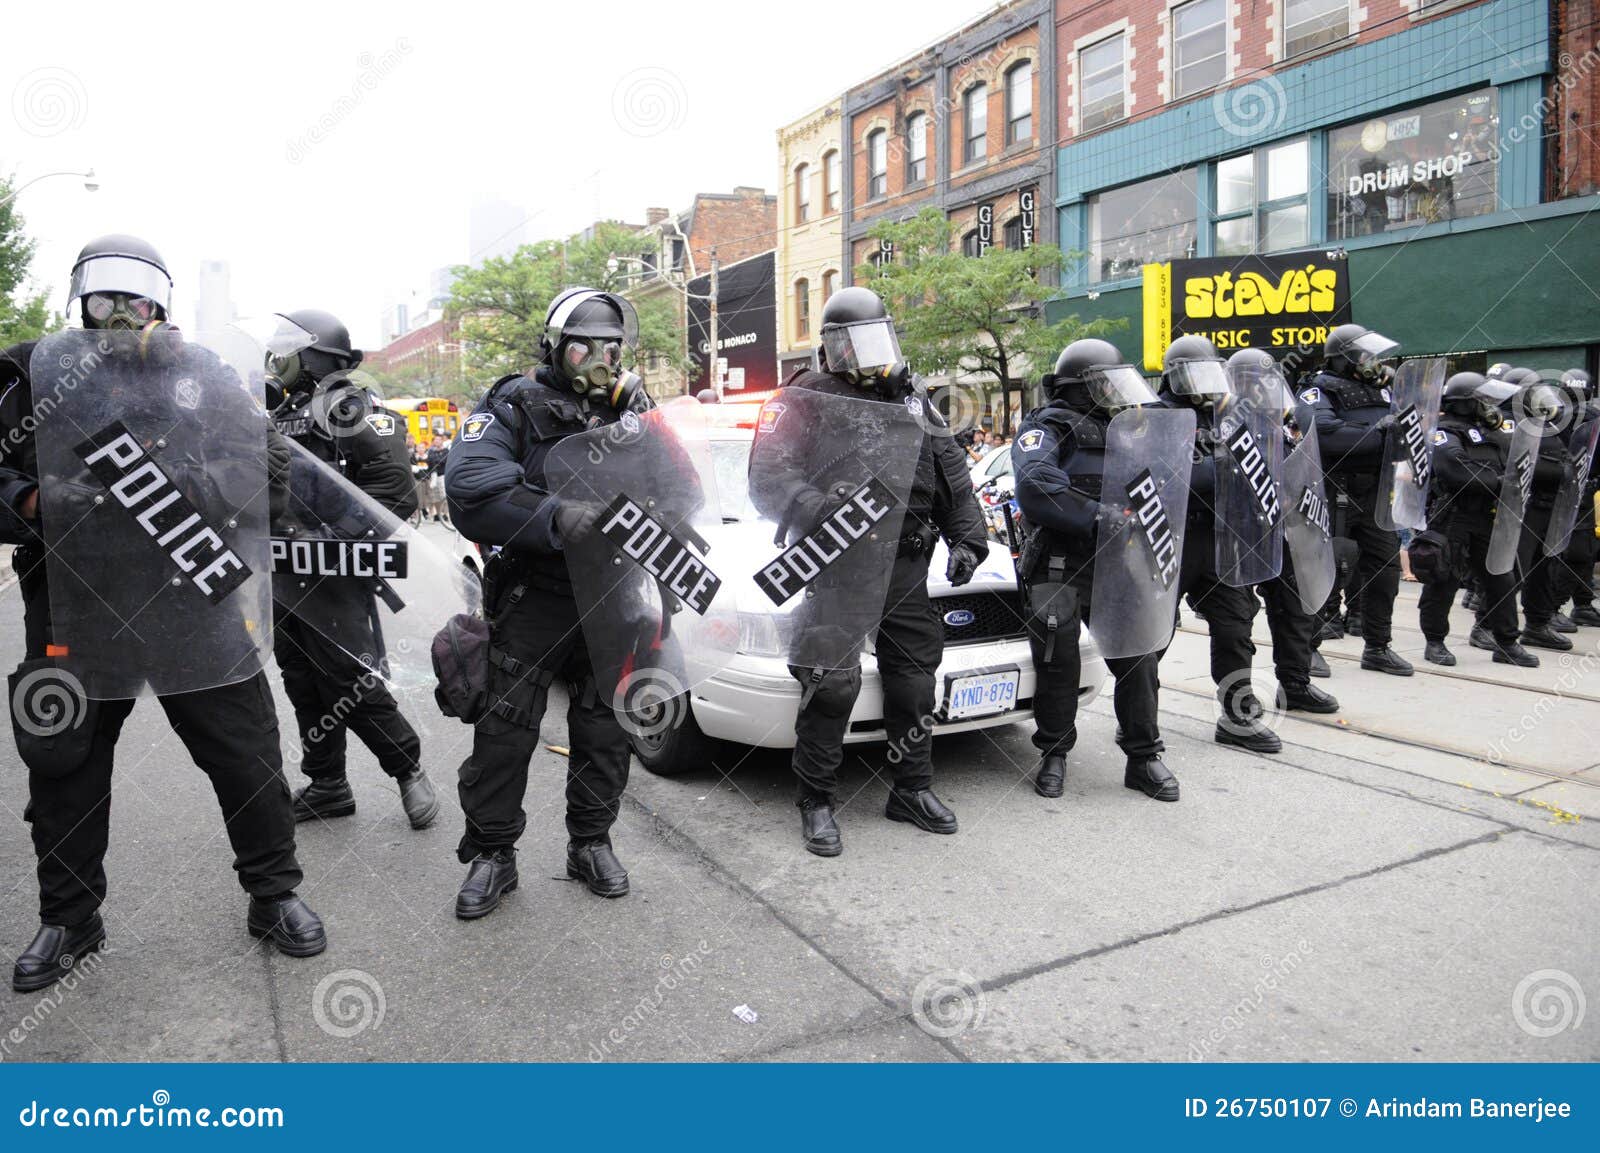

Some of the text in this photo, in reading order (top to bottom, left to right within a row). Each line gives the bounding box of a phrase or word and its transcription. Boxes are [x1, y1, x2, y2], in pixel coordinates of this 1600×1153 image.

[1349, 151, 1473, 197] DRUM SHOP
[703, 332, 757, 353] CB MONACO
[1183, 325, 1337, 349] USIC STOR
[1230, 430, 1280, 526] POLICE
[1400, 409, 1430, 485] POLICE
[84, 432, 243, 596] POLICE
[603, 500, 718, 608] POLICE
[762, 485, 890, 599] POLICE
[1128, 475, 1178, 585] POLICE
[270, 540, 398, 577] POLICE
